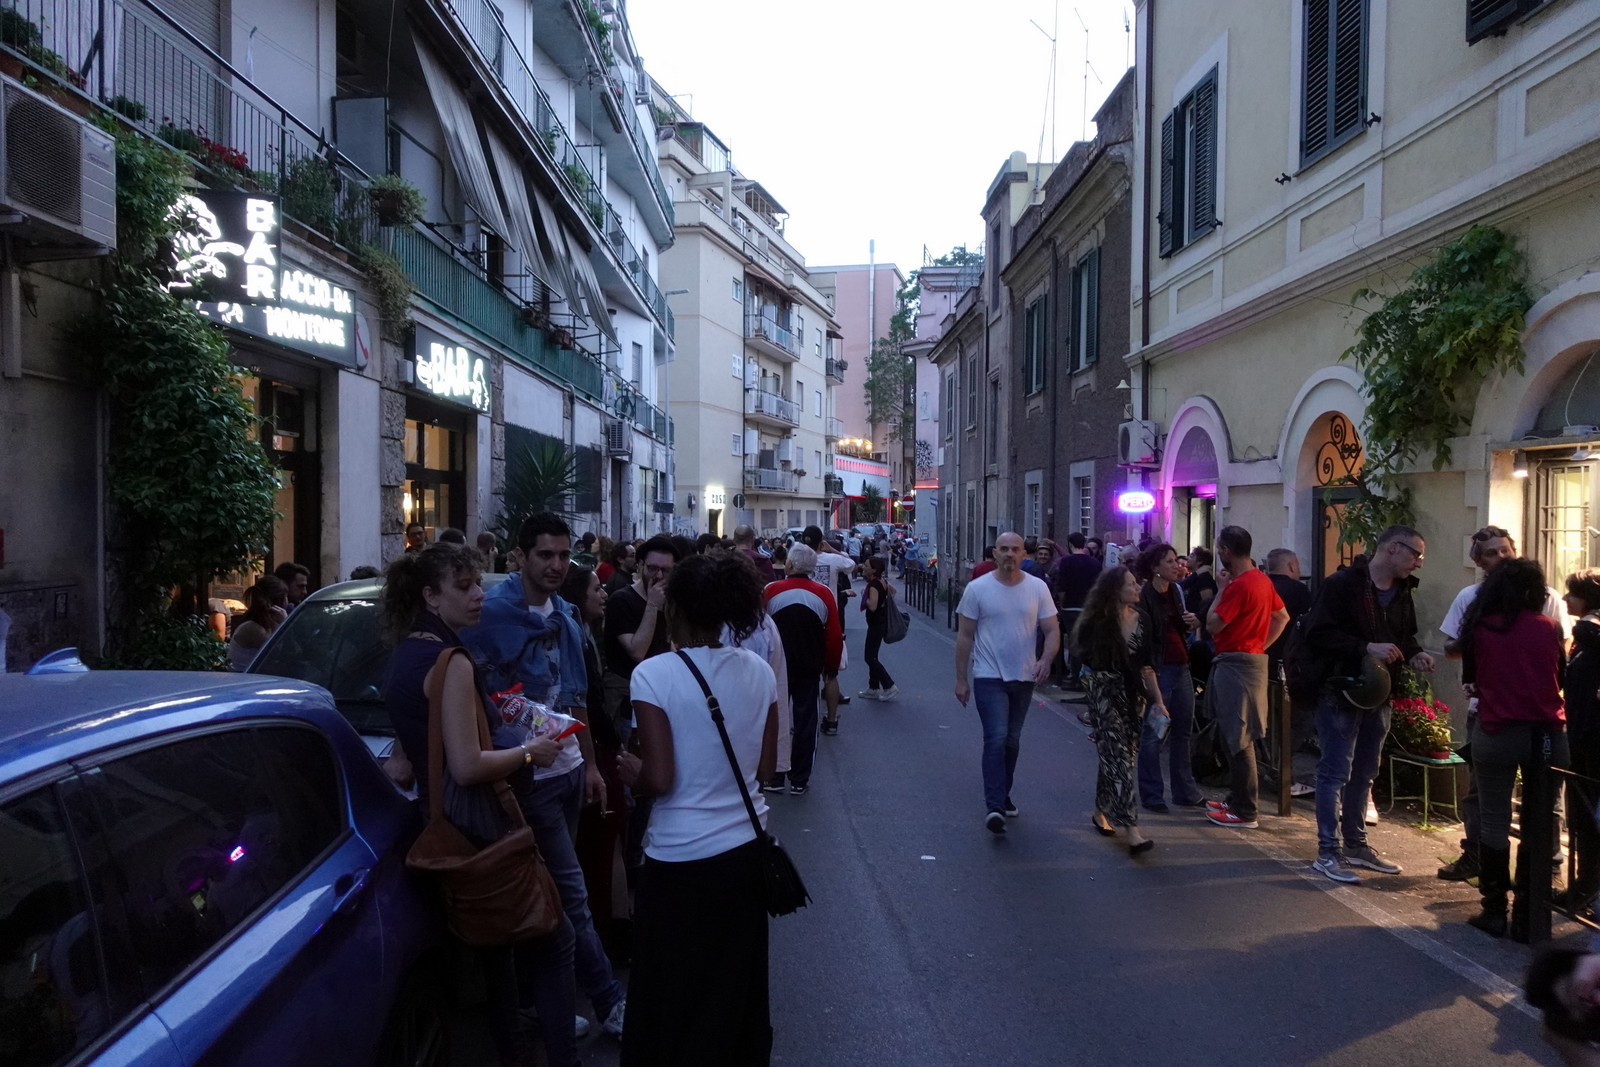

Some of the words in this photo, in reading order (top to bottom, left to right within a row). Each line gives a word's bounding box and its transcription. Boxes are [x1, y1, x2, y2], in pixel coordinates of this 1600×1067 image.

[244, 198, 277, 299] BAR
[264, 306, 346, 347] MONTONE
[430, 342, 470, 397] BAR
